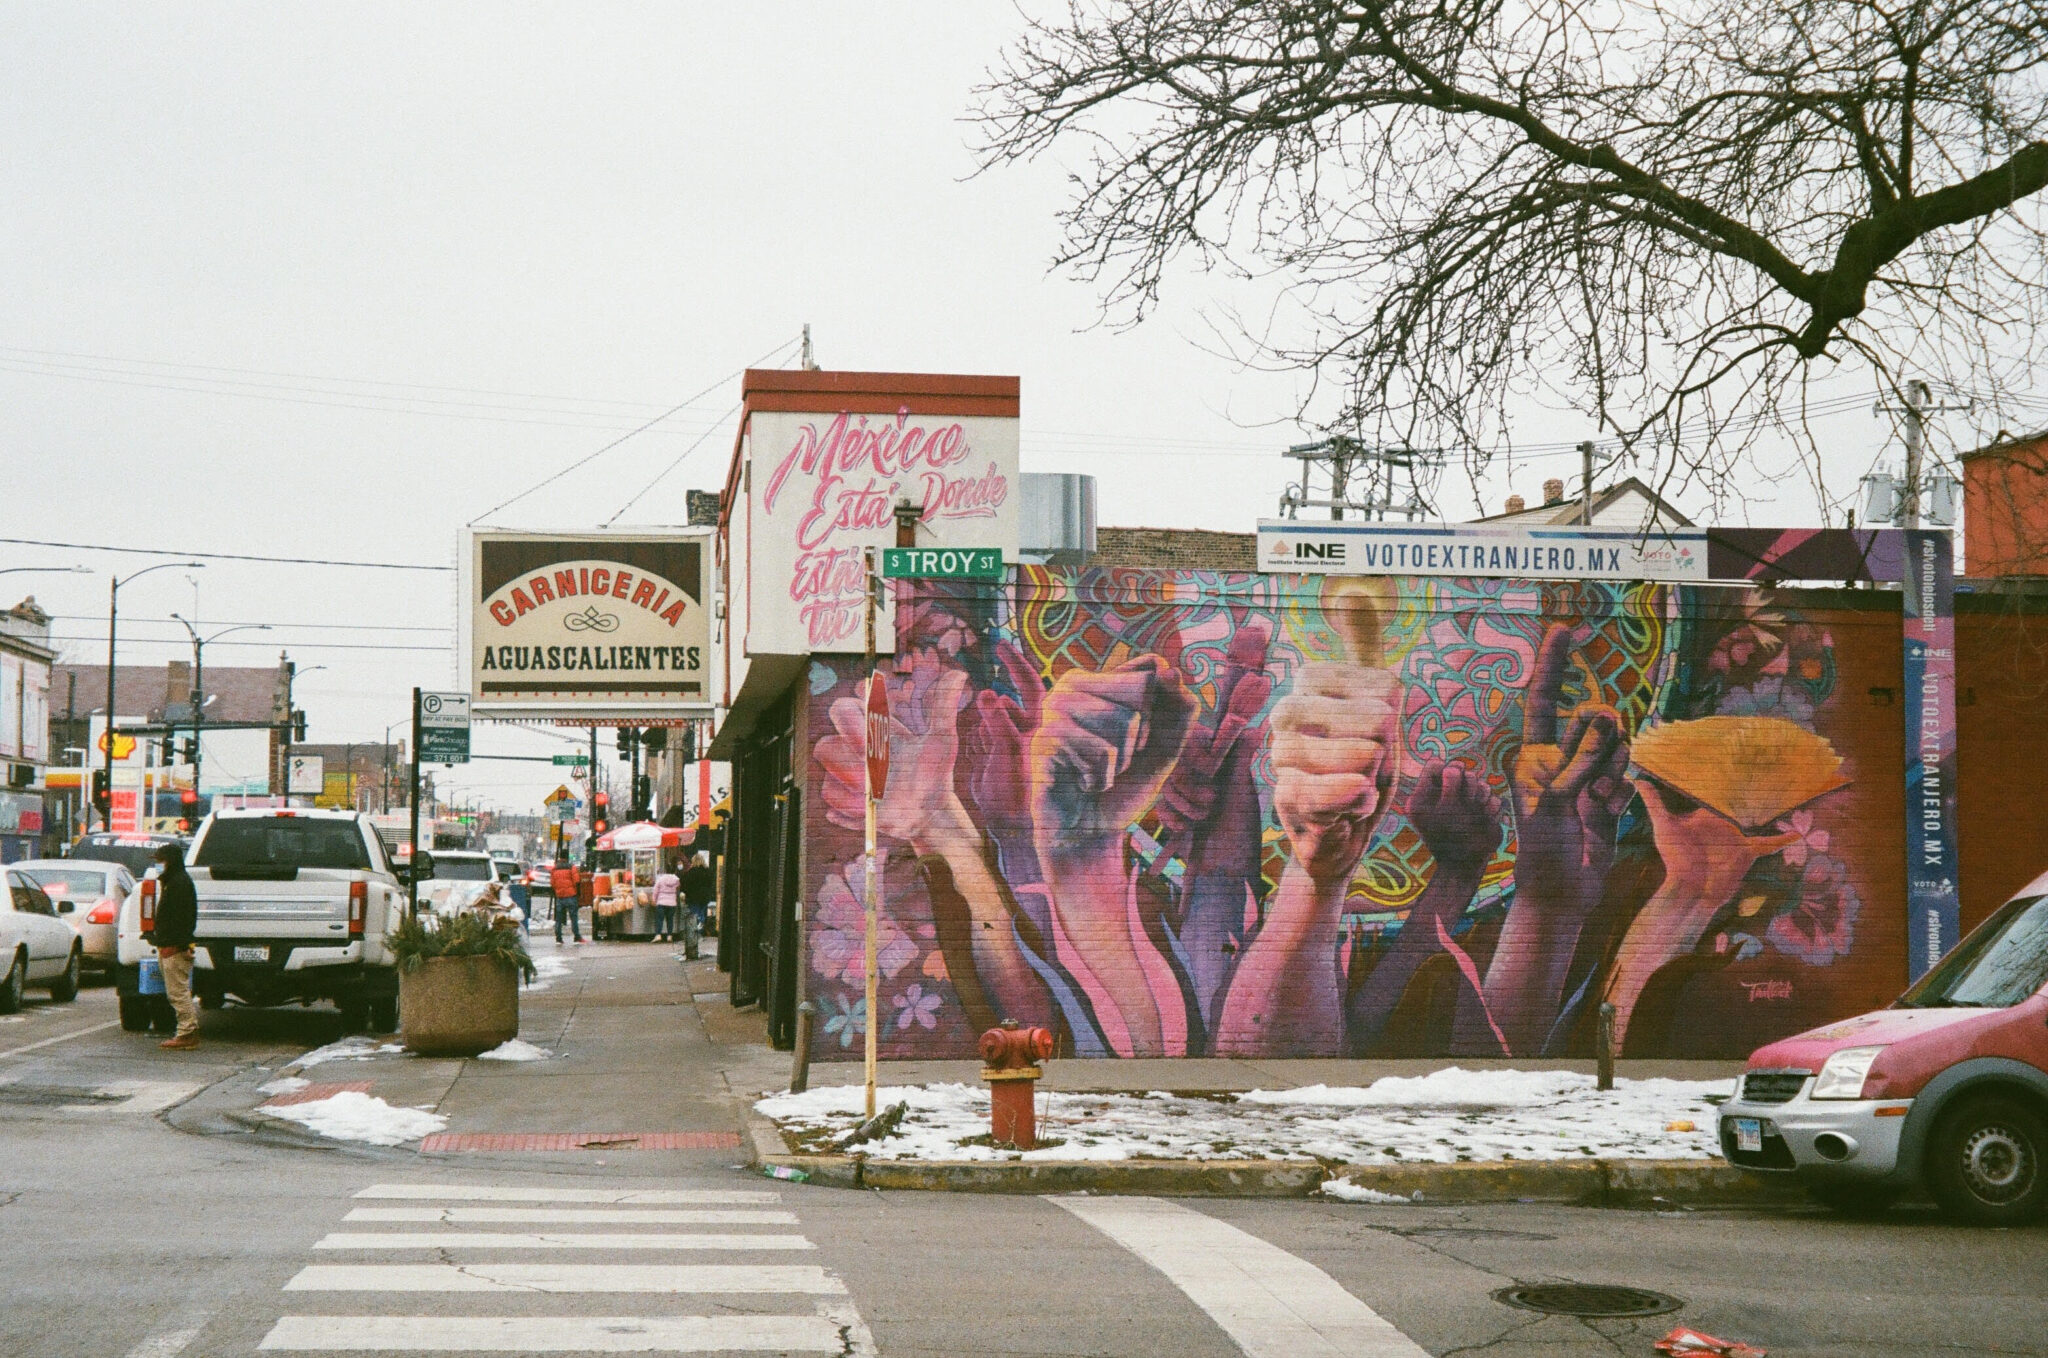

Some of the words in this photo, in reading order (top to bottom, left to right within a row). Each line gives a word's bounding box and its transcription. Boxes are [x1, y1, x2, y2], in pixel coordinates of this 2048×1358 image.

[919, 461, 1008, 523] Donde
[892, 556, 899, 568] S
[906, 551, 975, 574] TROY
[981, 556, 994, 569] ST
[1296, 543, 1345, 558] INE
[1365, 542, 1620, 572] VOTOEXTRANJERO.MX
[489, 568, 686, 627] CARNICERIA
[481, 645, 700, 670] AGUASCALIENTES
[1924, 648, 1952, 658] INE
[868, 711, 888, 761] STOP
[1921, 673, 1942, 866] VOTOEXTRANJERO.MX
